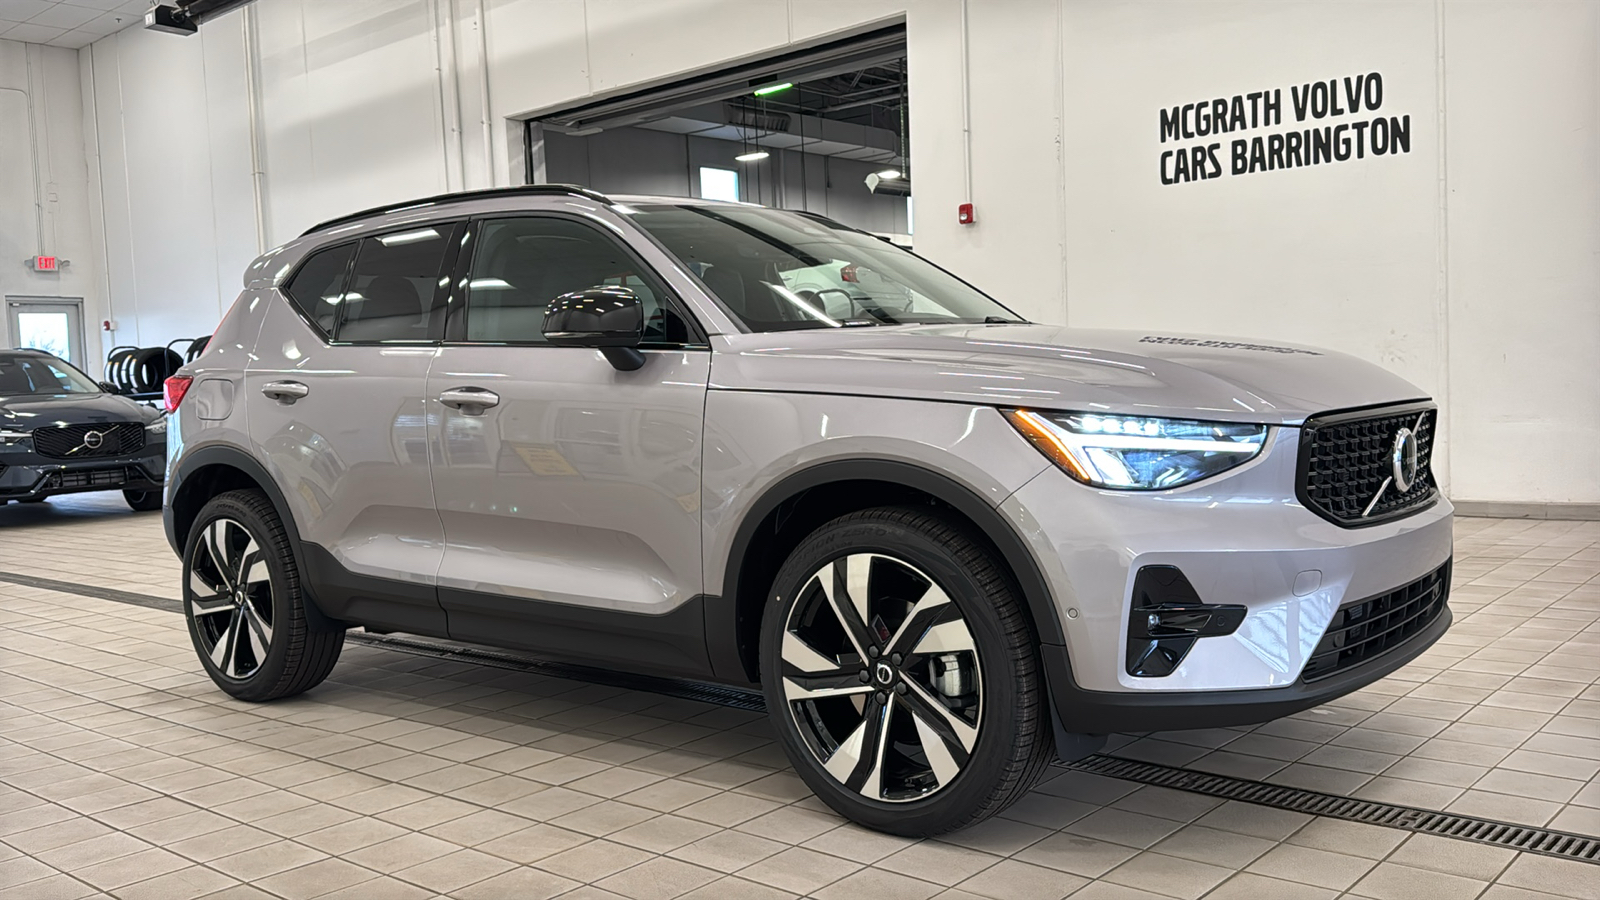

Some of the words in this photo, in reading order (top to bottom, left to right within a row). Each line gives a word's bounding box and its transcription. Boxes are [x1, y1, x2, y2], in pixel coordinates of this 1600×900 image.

[1160, 88, 1281, 143] MCGRATH
[1291, 71, 1383, 122] VOLVO
[1160, 143, 1222, 185] CARS
[1231, 114, 1411, 176] BARRINGTON
[38, 256, 55, 269] EXIT
